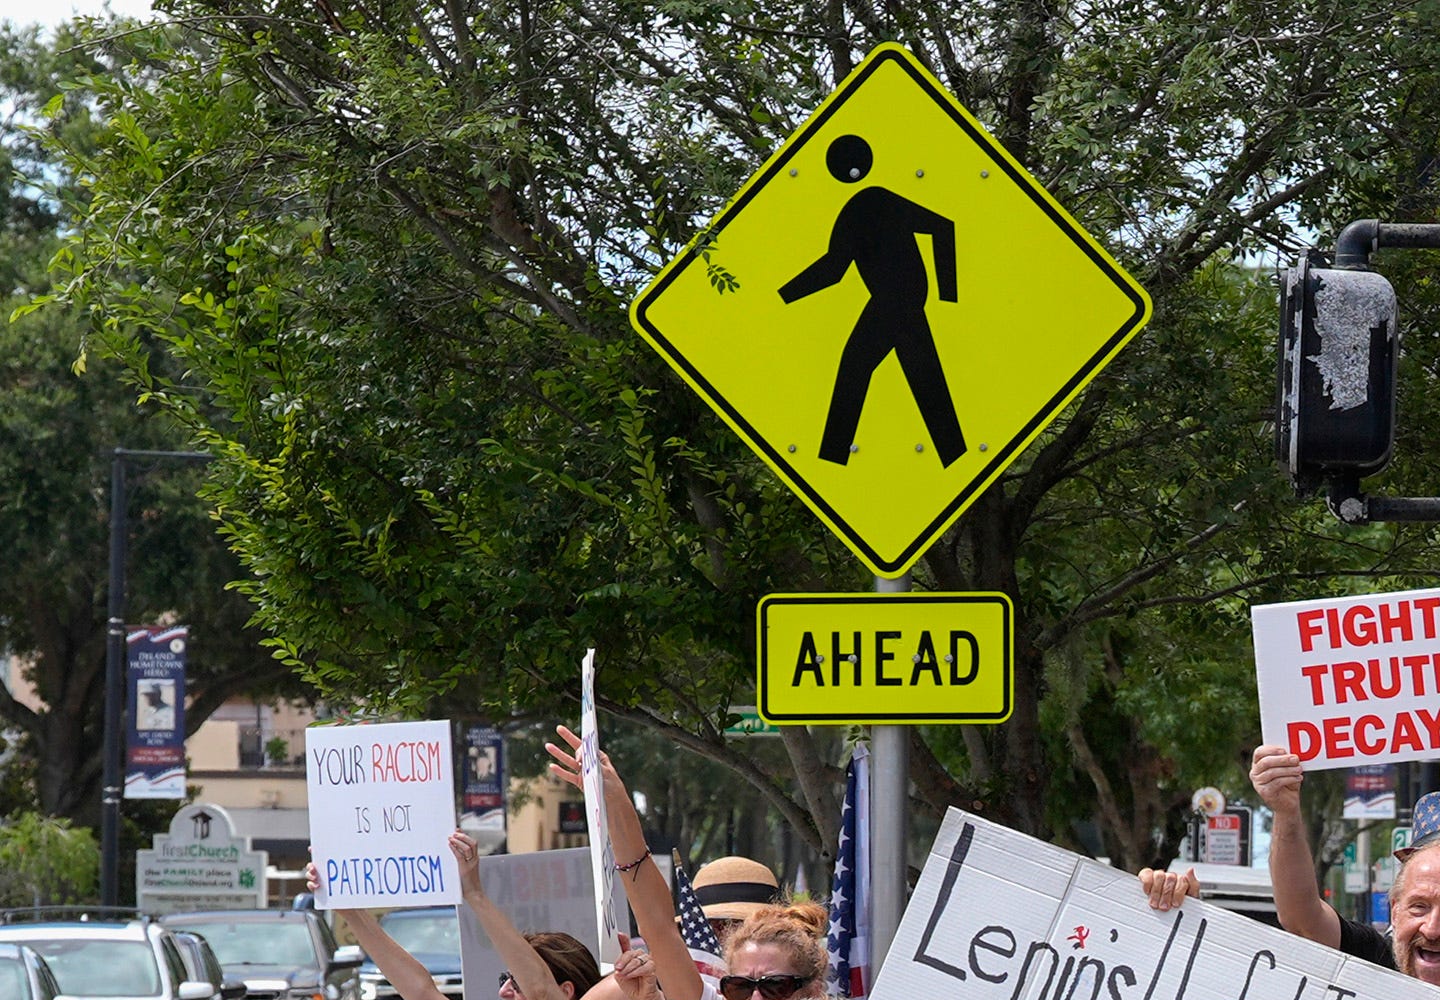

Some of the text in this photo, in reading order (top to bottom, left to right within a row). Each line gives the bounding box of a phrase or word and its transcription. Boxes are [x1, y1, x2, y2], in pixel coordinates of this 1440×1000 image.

[1297, 597, 1440, 652] FIGHT
[791, 630, 980, 687] AHEAD
[313, 741, 442, 786] YOUR RACISM
[355, 805, 411, 834] IS NOT
[326, 855, 444, 897] PATRIOTISM
